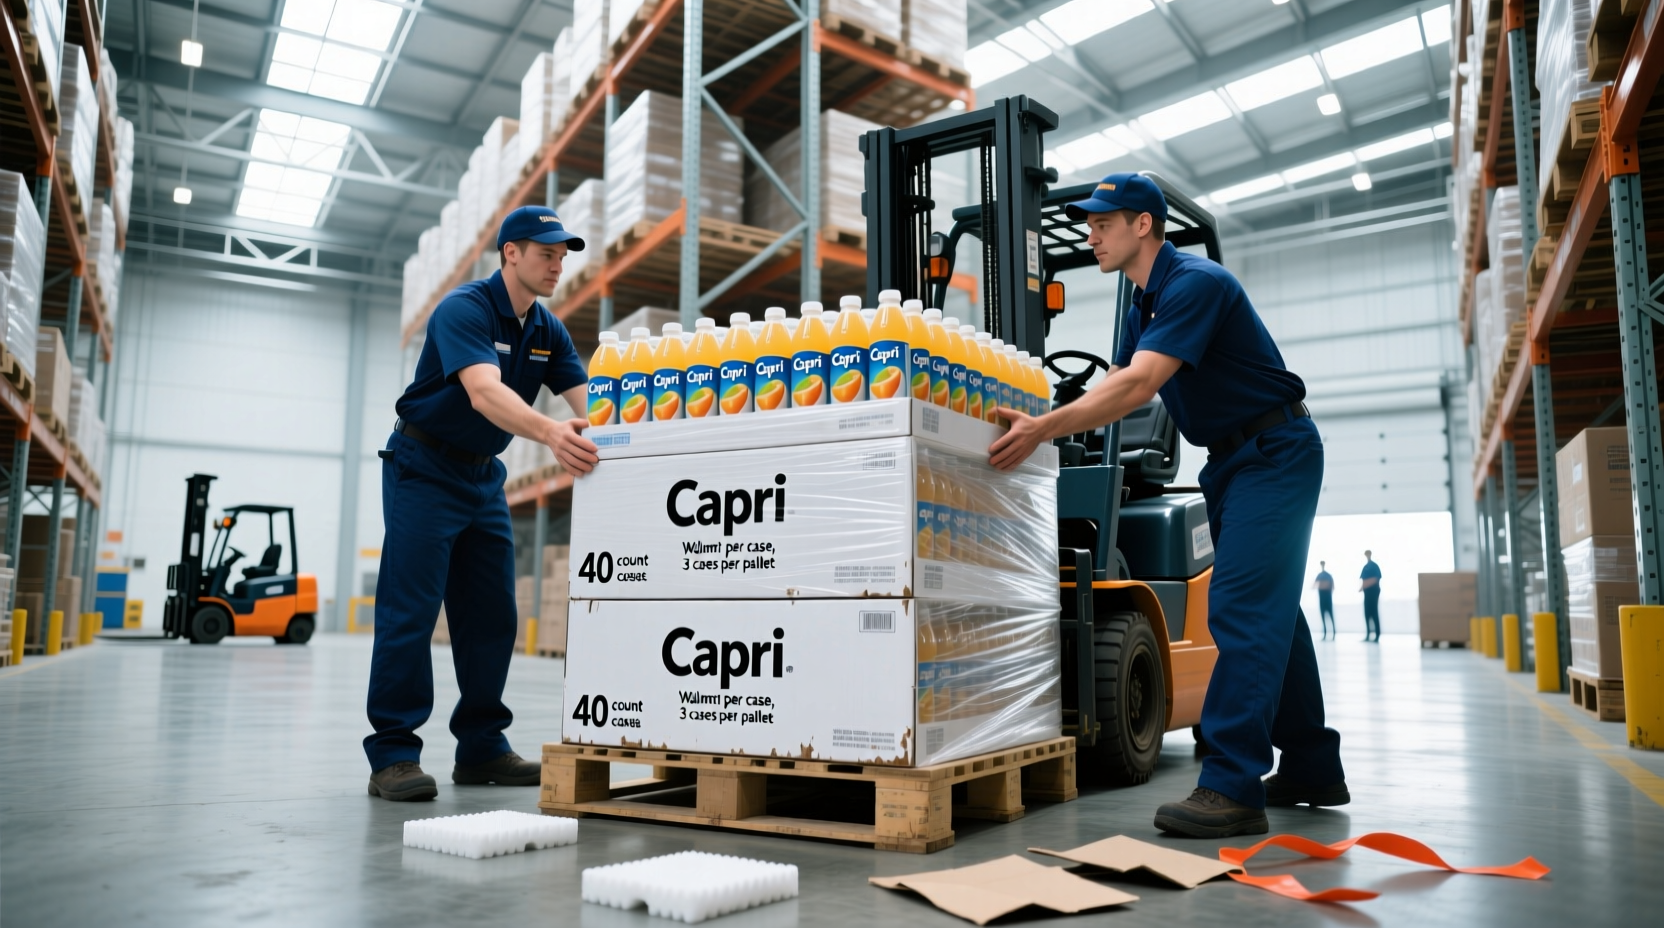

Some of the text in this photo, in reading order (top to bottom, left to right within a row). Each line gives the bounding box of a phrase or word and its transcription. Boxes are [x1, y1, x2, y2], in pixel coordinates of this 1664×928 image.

[870, 346, 899, 364] Capri
[667, 473, 787, 537] Capri
[725, 543, 744, 559] per
[578, 551, 649, 584] 40 count
[682, 558, 690, 571] 3
[721, 559, 741, 575] per
[743, 556, 776, 574] pallet
[661, 626, 785, 690] Capri
[573, 694, 644, 728] 40 count
[723, 695, 743, 709] per
[745, 696, 775, 710] case,
[679, 706, 687, 720] 3
[719, 712, 738, 725] per
[741, 709, 774, 726] pallet
